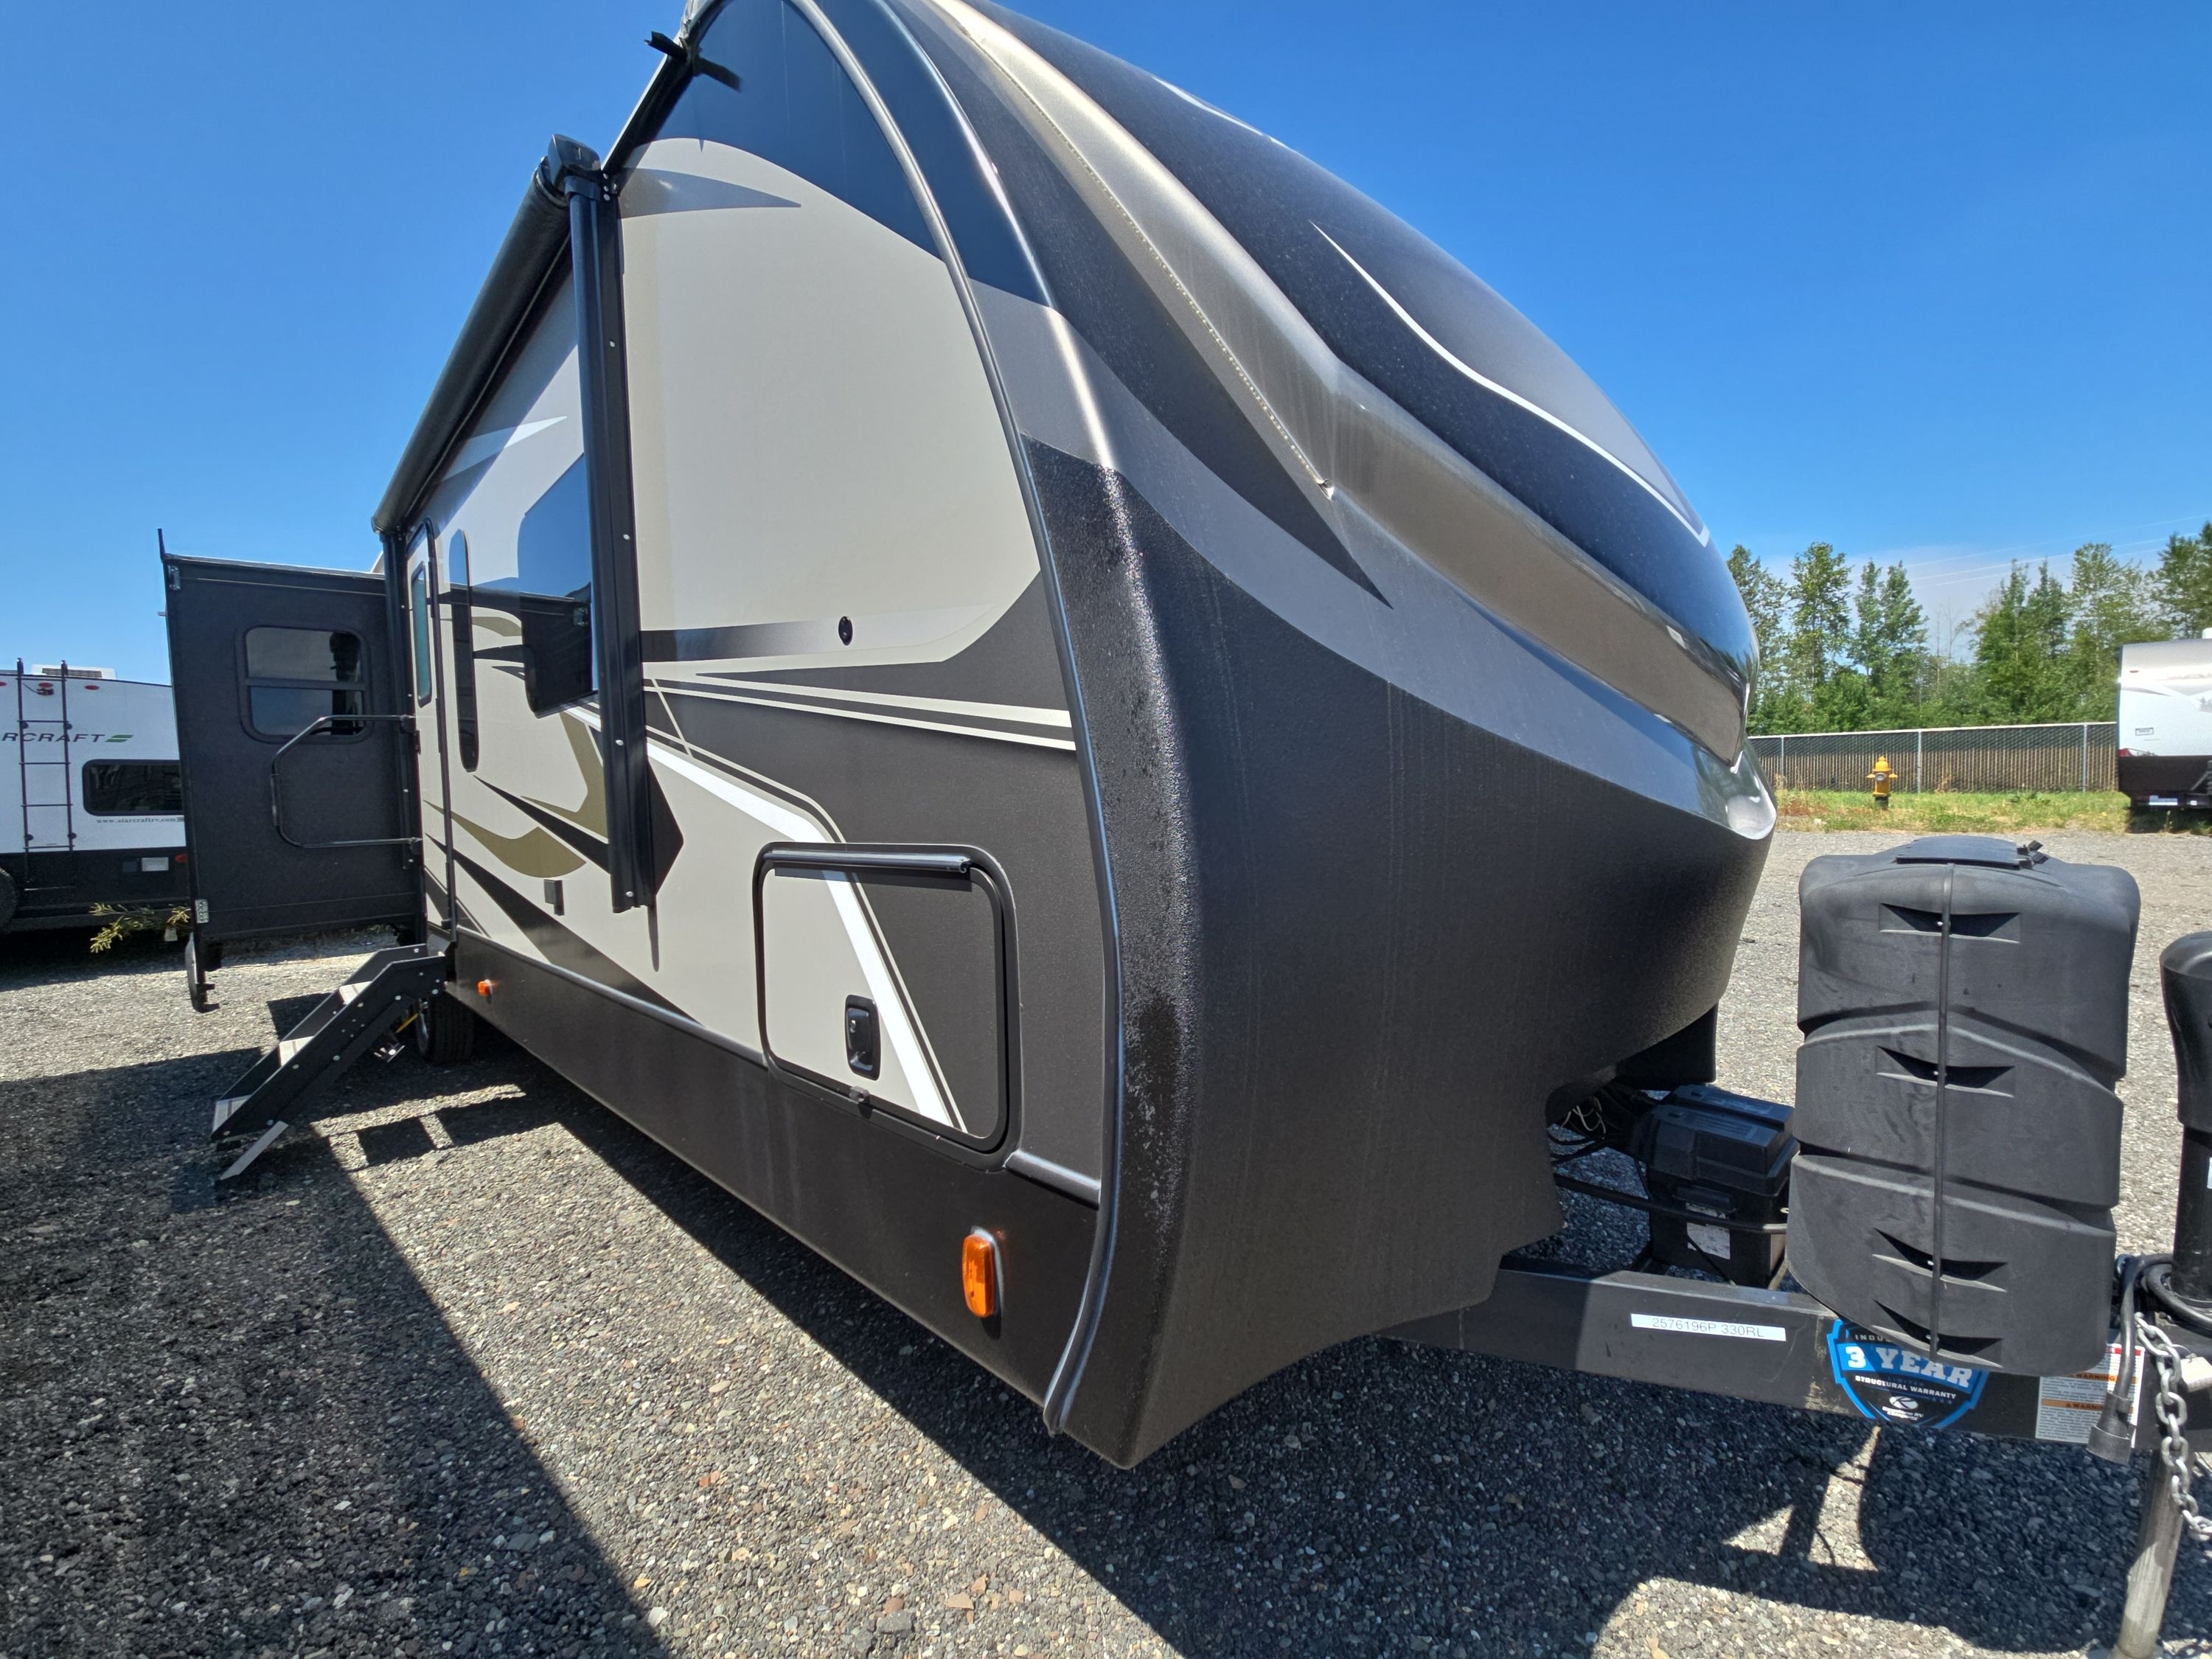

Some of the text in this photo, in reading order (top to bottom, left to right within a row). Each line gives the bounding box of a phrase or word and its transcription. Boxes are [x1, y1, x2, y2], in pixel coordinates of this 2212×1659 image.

[1652, 1317, 1764, 1338] 2576196P 330RL
[1854, 1334, 1892, 1343] INDU
[1845, 1346, 1972, 1388] 3 YEAR
[1854, 1375, 1957, 1399] STRUCTURAL WARRANTY
